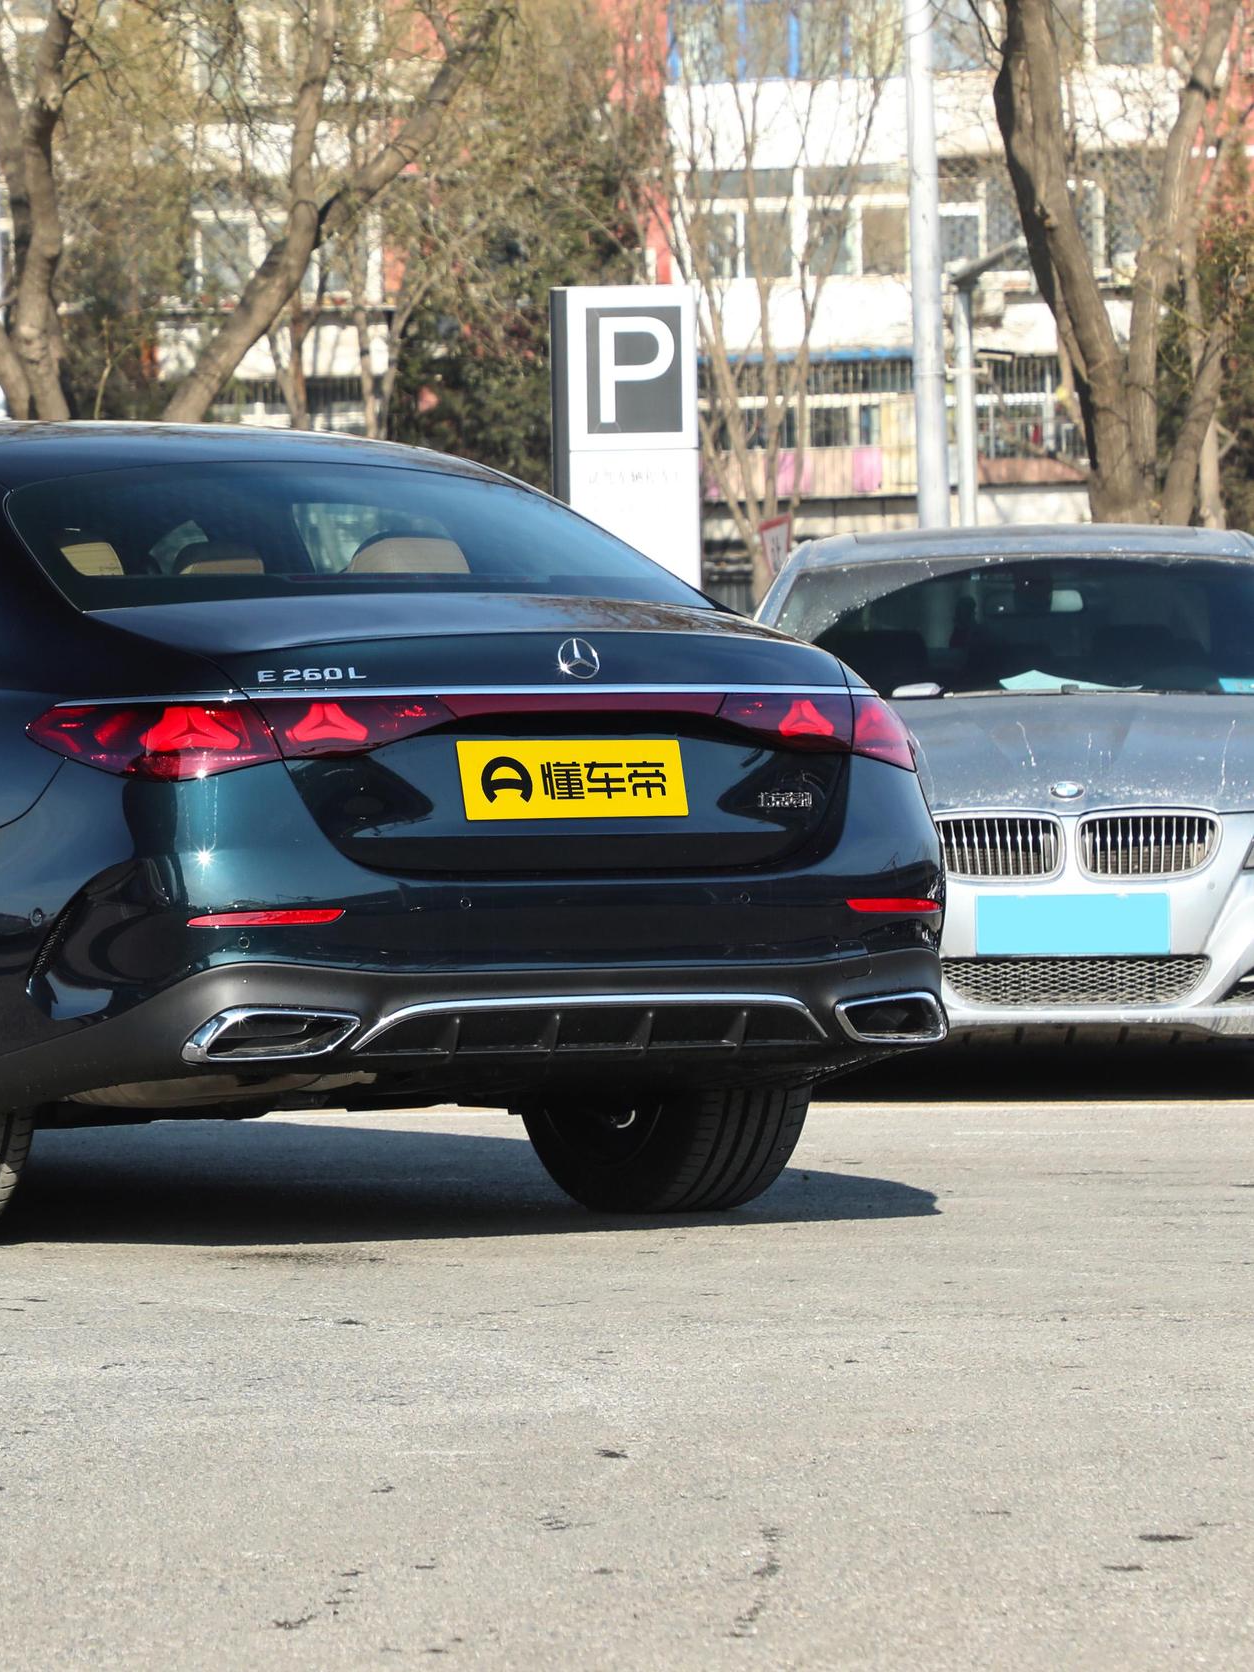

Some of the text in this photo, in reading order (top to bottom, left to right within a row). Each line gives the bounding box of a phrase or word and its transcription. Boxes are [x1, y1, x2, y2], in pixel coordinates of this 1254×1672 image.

[599, 316, 675, 423] P
[257, 667, 367, 682] E 260 L
[541, 761, 667, 800] 懂车帝
